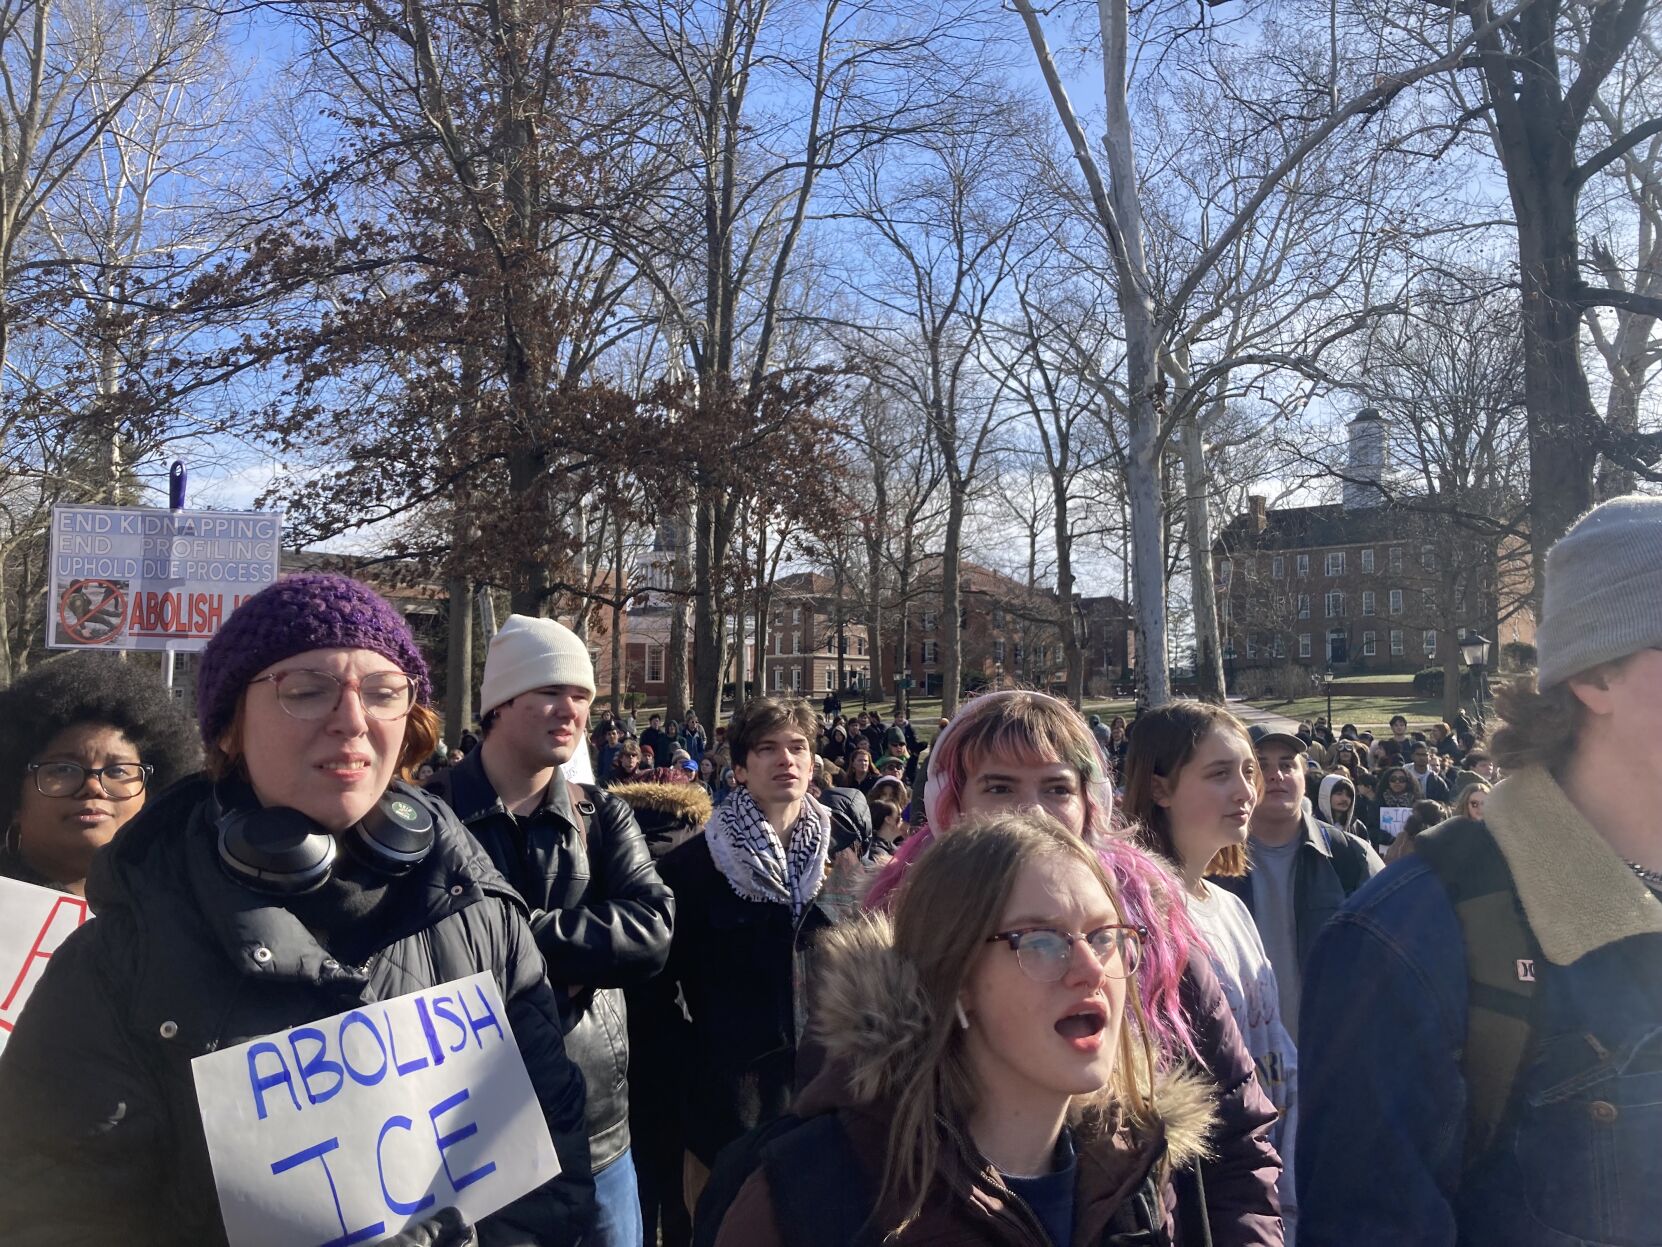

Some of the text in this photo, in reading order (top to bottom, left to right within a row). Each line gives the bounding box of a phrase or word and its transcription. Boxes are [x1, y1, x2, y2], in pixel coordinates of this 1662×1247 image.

[59, 512, 274, 539] END KIDNAPPING
[59, 535, 273, 560] END PROFILING
[58, 556, 272, 582] UPHOLD DUE PROCESS
[128, 591, 223, 633] ABOLISH
[247, 984, 504, 1120] ABOLISH
[270, 1087, 497, 1247] ICE
